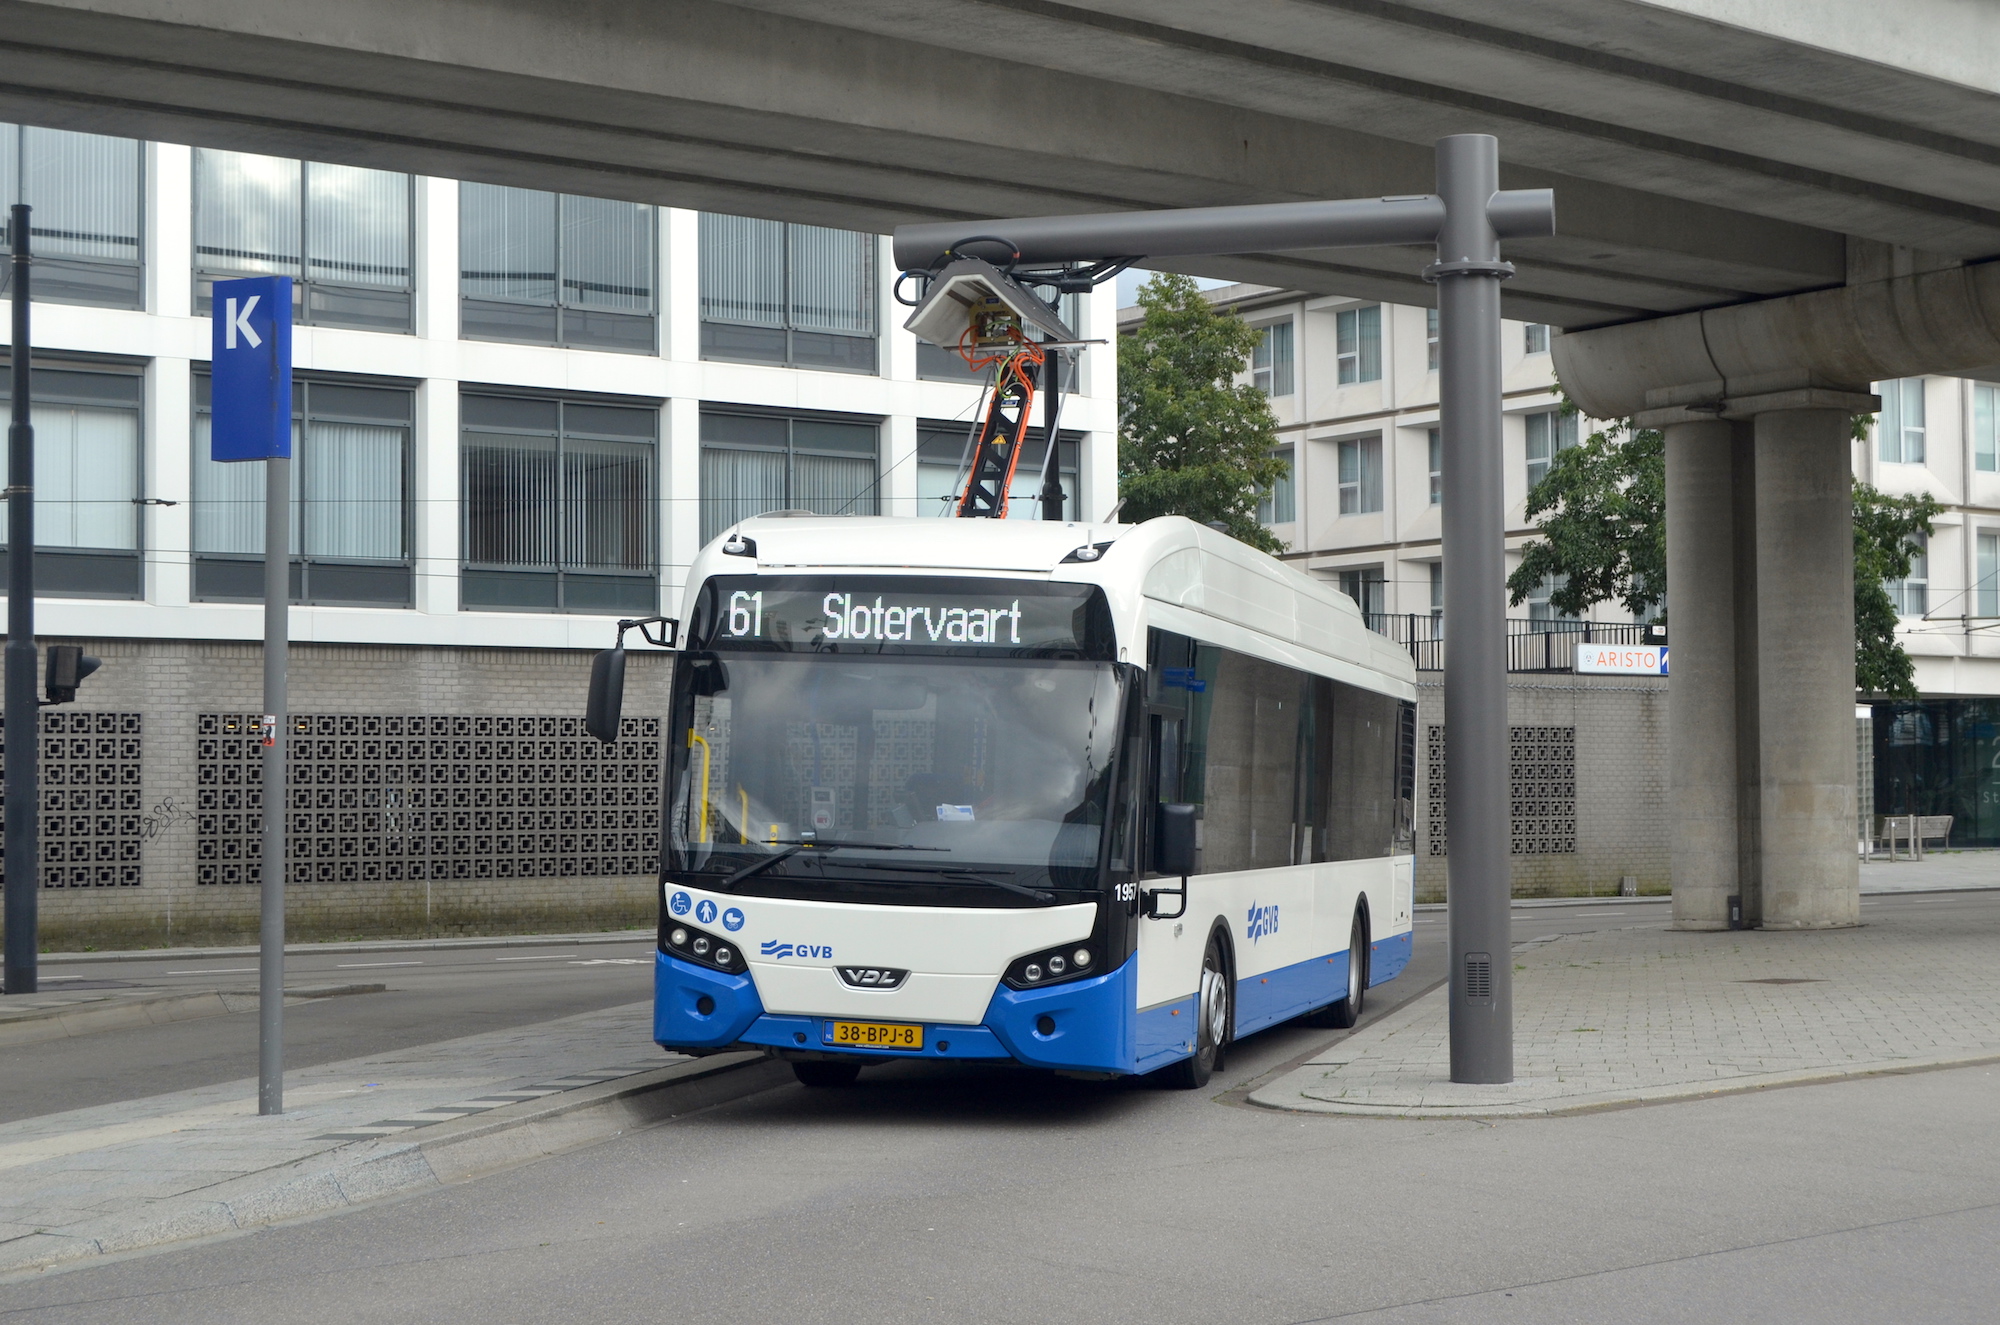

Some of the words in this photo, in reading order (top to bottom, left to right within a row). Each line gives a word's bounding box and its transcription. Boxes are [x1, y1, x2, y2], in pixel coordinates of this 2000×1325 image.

[226, 295, 262, 349] K
[729, 591, 762, 636] 61
[822, 592, 1021, 643] Slotervaart
[1596, 651, 1656, 668] ARISTO
[1114, 882, 1137, 901] 1957
[1263, 905, 1279, 936] GVB
[796, 945, 833, 959] GVB
[845, 969, 896, 984] VDL
[840, 1025, 914, 1044] 38-BPJ-8
